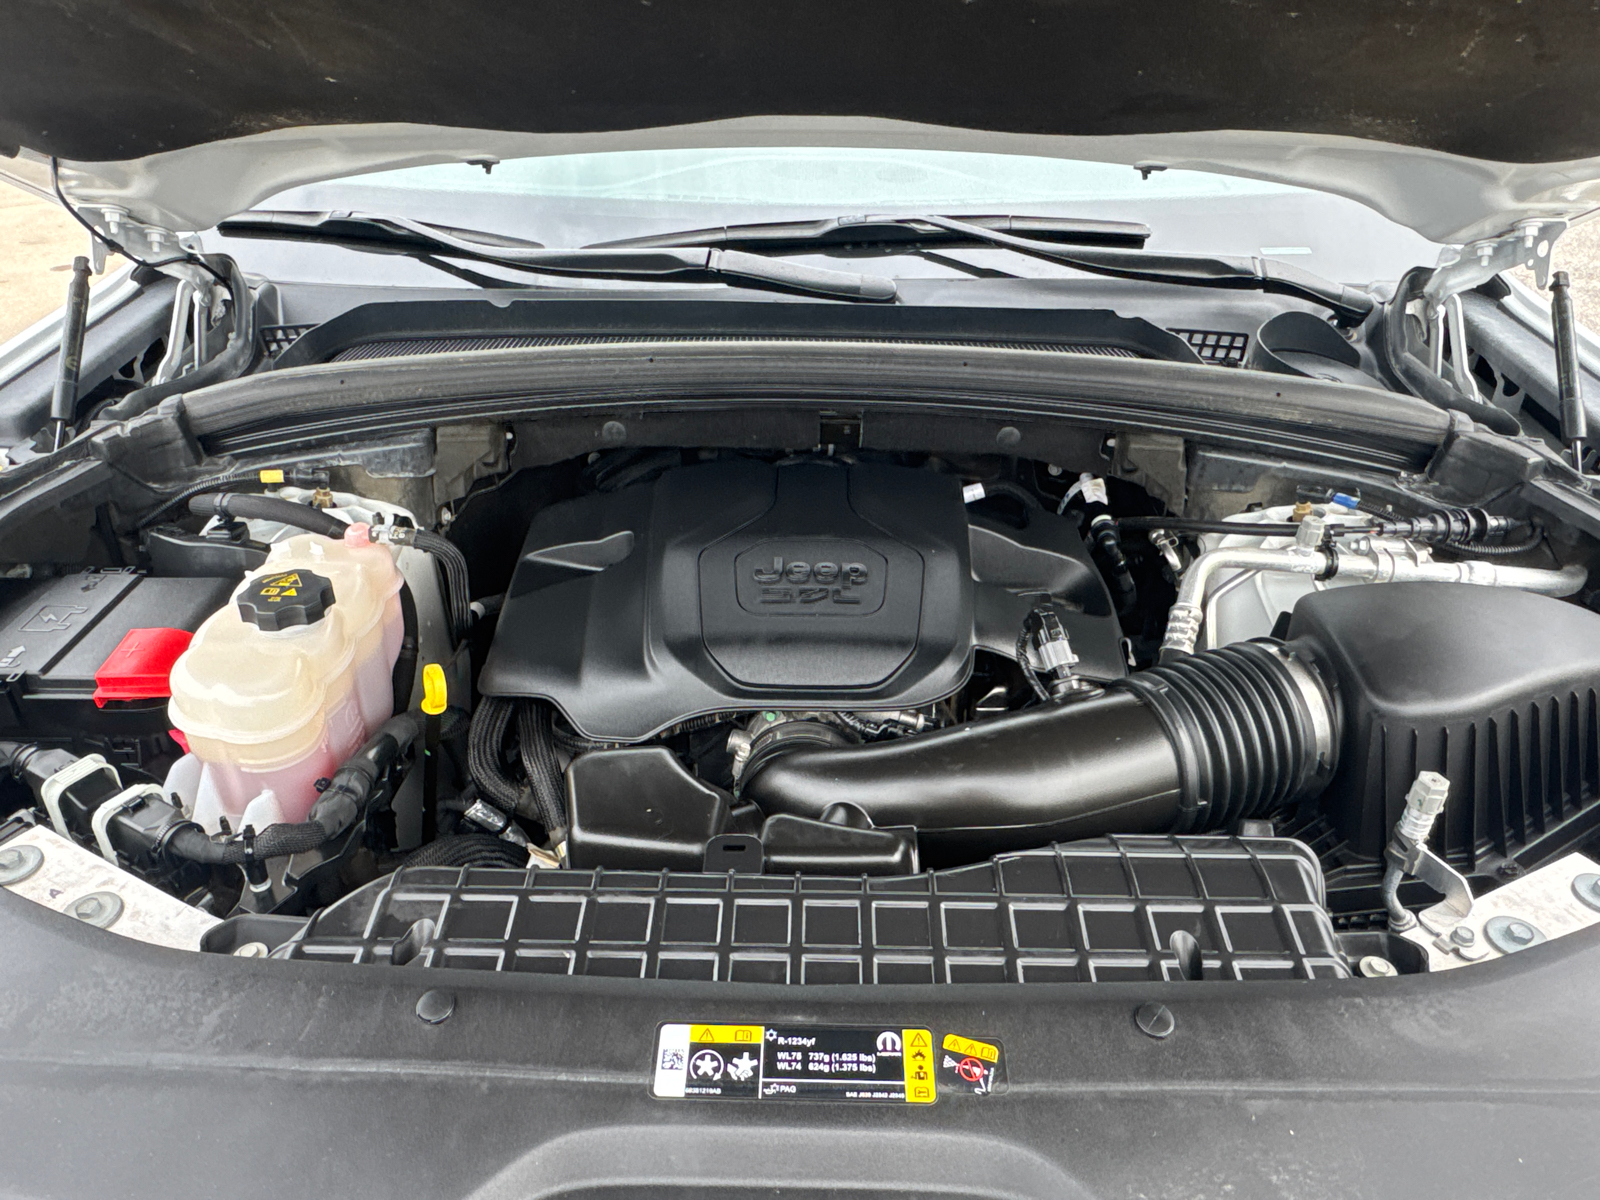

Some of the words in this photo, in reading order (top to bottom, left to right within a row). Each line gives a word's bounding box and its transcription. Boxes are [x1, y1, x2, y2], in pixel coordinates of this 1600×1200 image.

[753, 556, 868, 589] Jeep
[777, 1037, 816, 1047] R-1234yf
[808, 1052, 830, 1063] 737g
[859, 1053, 876, 1064] lbs)
[777, 1062, 802, 1070] WL74
[859, 1063, 876, 1074] lbs)
[780, 1085, 797, 1094] PAG
